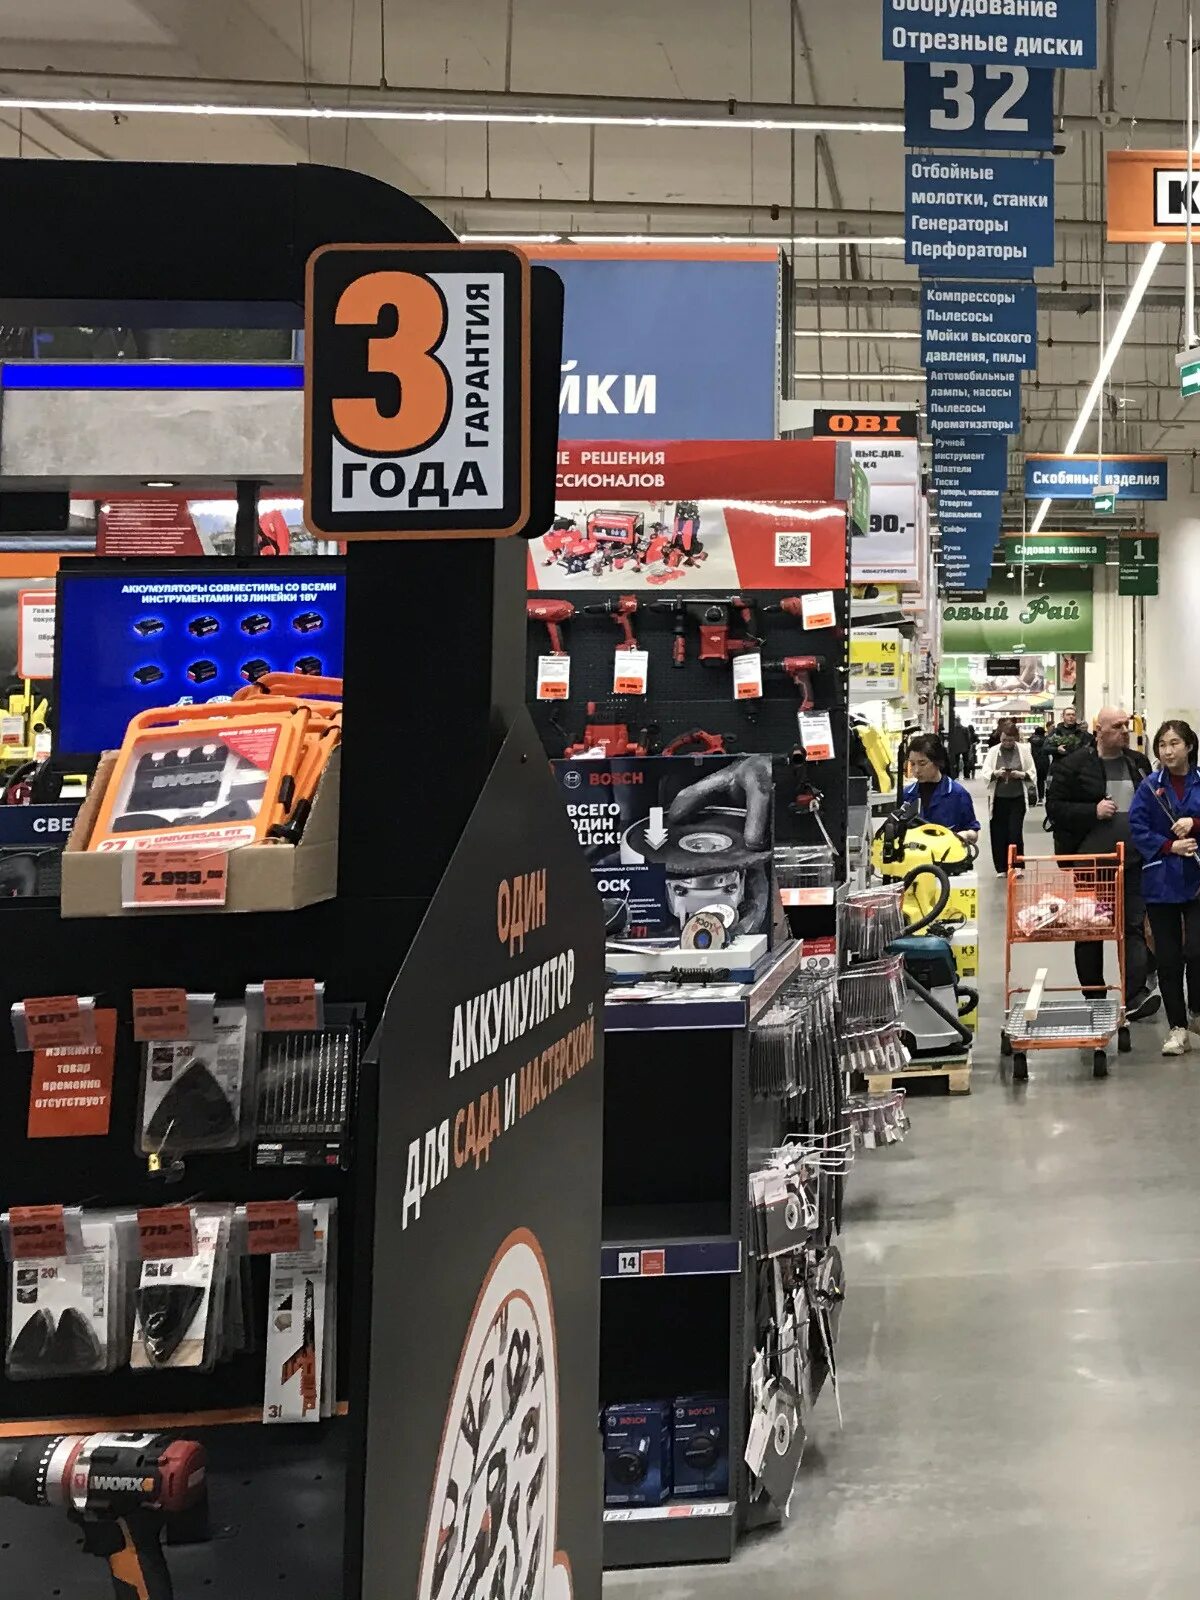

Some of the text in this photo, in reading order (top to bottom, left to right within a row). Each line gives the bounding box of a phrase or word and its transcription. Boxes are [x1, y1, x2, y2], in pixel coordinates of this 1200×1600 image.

[892, 27, 1083, 57] Отрезные диски
[929, 62, 1030, 132] 32
[912, 163, 993, 180] Отбойные
[911, 192, 1048, 208] молотки, станки
[911, 215, 1009, 233] Генераторы
[911, 241, 1027, 260] Перфораторы
[927, 289, 1015, 305] Компрессоры
[927, 309, 993, 322] Пылесосы
[926, 329, 1031, 343] Мойки высокого
[331, 270, 450, 453] 3
[925, 352, 1026, 364] давления, пилы
[465, 283, 490, 449] ГАРАНТИЯ
[931, 370, 1015, 381] Автомобильные
[930, 388, 1011, 398] лампы, насосы
[931, 403, 986, 413] Пылесосы
[828, 414, 902, 432] OBI
[931, 419, 1013, 430] Ароматизаторы
[581, 451, 665, 465] РЕШЕНИЯ
[341, 459, 489, 509] ГОДА
[1033, 471, 1160, 487] Скобяные изделия
[1014, 545, 1097, 556] Садовая техника
[1133, 540, 1145, 560] 1
[121, 583, 337, 594] АККУМУЛЯТОРЫ СОВМЕСТИМЫ СО ВСЕМИ
[141, 592, 318, 604] ИНСТРУМЕНТАМИ ИЗ ЛИНЕЙКИ 18V
[1019, 594, 1081, 624] Рай
[589, 772, 644, 785] BOSCH
[566, 803, 620, 817] ВСЕГО
[154, 828, 242, 843] UNIVERSAL FIT
[497, 868, 547, 958] ОДИН
[449, 948, 575, 1079] АККУМУЛЯТОР
[57, 1063, 91, 1073] товар
[42, 1080, 101, 1091] временно
[35, 1096, 106, 1108] отсутствует
[402, 1002, 595, 1231] ДЛЯ САДА И МАСТЕРСКОЙ
[622, 1257, 635, 1269] 14
[620, 1417, 646, 1425] BOSCH
